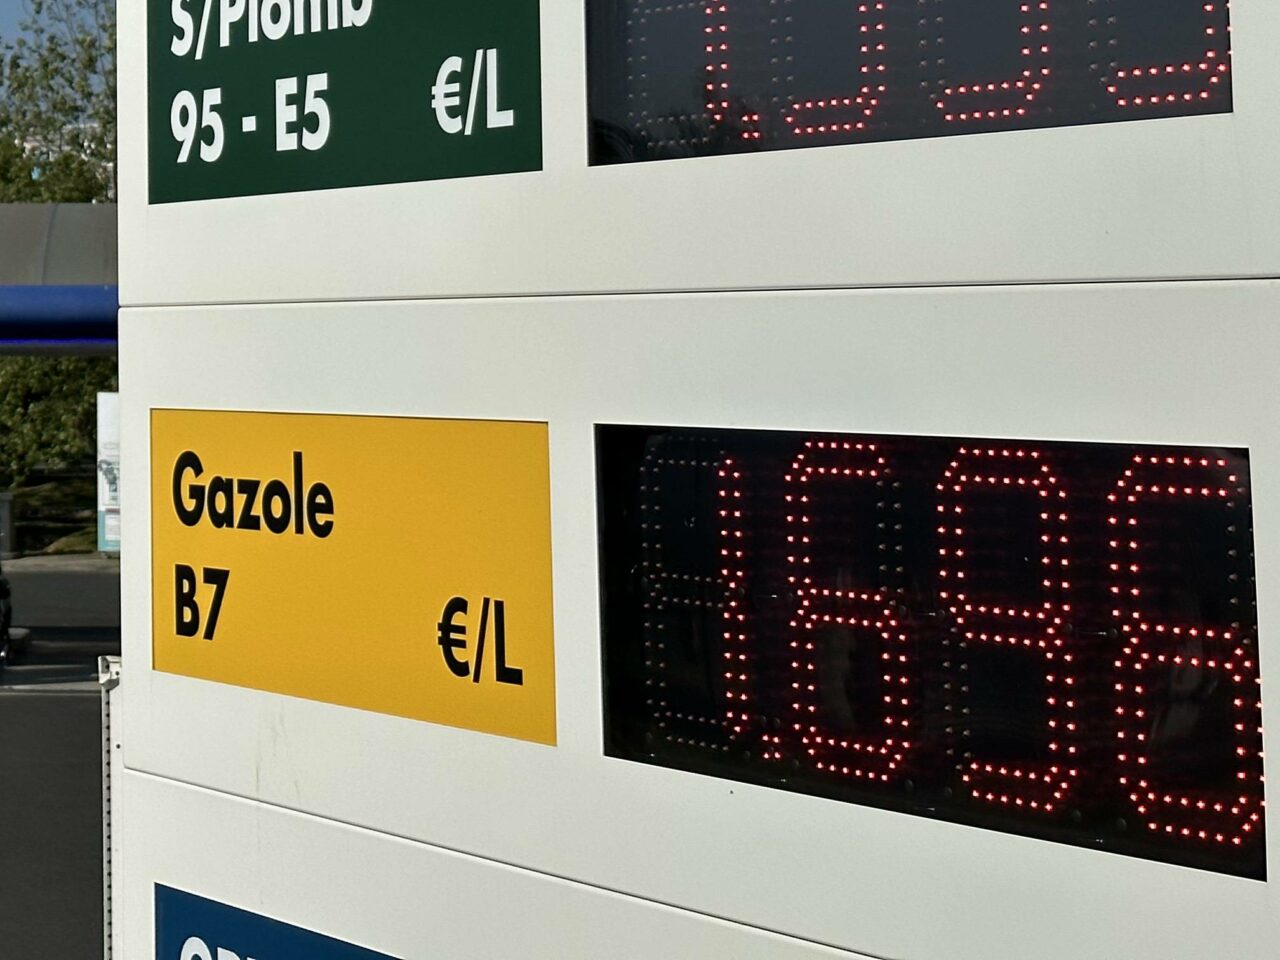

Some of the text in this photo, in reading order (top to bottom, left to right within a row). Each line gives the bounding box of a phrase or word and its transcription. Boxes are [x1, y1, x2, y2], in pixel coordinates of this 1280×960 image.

[170, 72, 331, 163] 95 - E5
[431, 48, 514, 136] €/L
[172, 450, 335, 539] Gazole
[175, 564, 230, 641] B7
[437, 596, 524, 687] €/L
[718, 439, 1266, 845] 1.696
